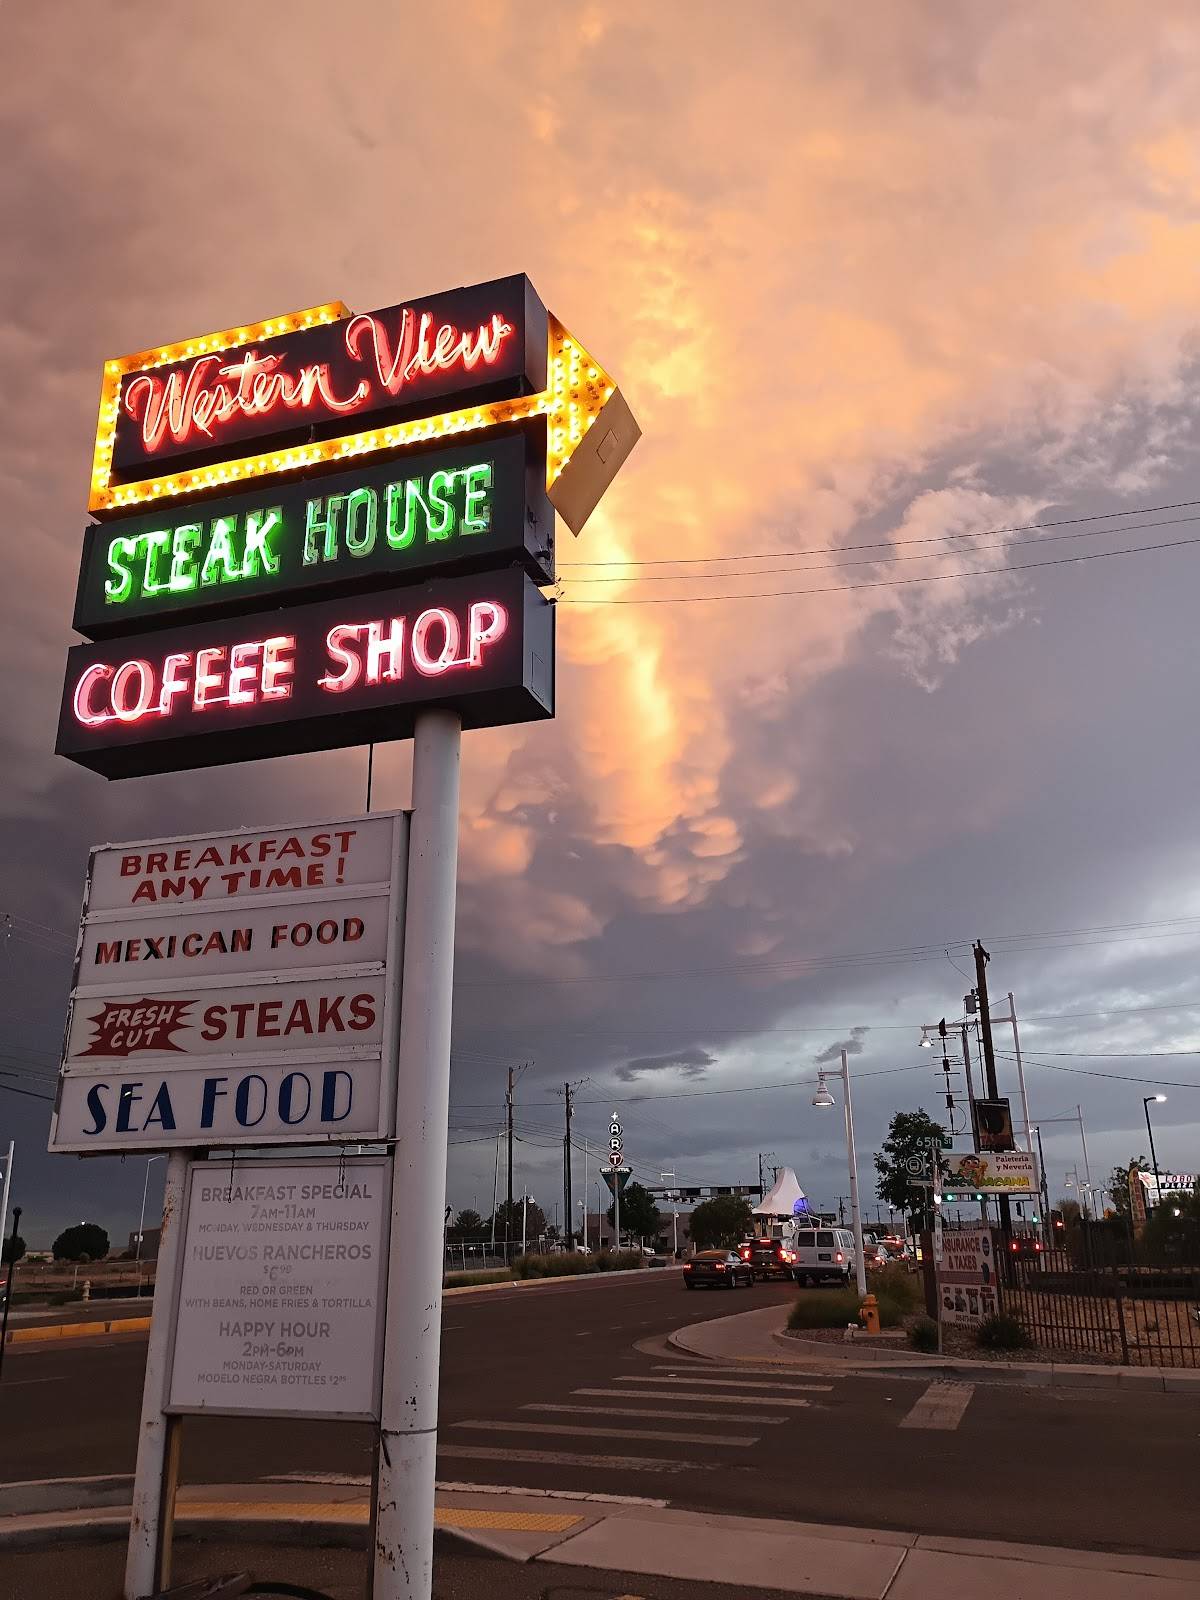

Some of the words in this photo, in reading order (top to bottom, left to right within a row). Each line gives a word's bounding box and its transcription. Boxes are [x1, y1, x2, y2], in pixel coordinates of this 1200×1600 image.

[125, 349, 368, 453] Western
[345, 306, 515, 396] View
[105, 505, 283, 604] STEAK
[302, 462, 495, 567] HOUSE
[73, 634, 297, 728] COFFEE
[318, 600, 509, 693] SHOP
[120, 831, 357, 877] BREAKFAST
[132, 875, 211, 903] ANY
[220, 858, 346, 895] TIME!
[95, 928, 253, 965] MEXICAN
[271, 917, 365, 949] FOOD
[104, 1005, 175, 1029] FRESH
[201, 993, 376, 1041] STEAKS
[110, 1026, 161, 1048] CUT
[82, 1081, 176, 1135] SEA
[200, 1070, 354, 1128] FOOD
[916, 1136, 942, 1148] 65th
[943, 1136, 952, 1145] St
[201, 1185, 297, 1202] BREAKFAST
[301, 1184, 373, 1199] SPECIAL
[306, 1222, 313, 1231] &
[316, 1221, 370, 1231] THURSDAY
[263, 1244, 372, 1261] RANCHEROS
[942, 1236, 980, 1253] NSURANCE
[954, 1255, 978, 1270] TAXES
[240, 1285, 259, 1295] RED
[262, 1285, 276, 1295] OR
[279, 1285, 313, 1295] GREEN
[185, 1298, 210, 1308] WITH
[212, 1298, 247, 1309] BEANS,
[249, 1298, 278, 1308] HOME
[281, 1298, 309, 1308] FRIES
[312, 1298, 319, 1308] &
[321, 1298, 372, 1308] TORTILLA
[219, 1322, 276, 1337] HAPPY
[280, 1322, 331, 1338] HOUR
[242, 1341, 304, 1357] 2PM-6PM
[197, 1373, 240, 1384] MODELO
[242, 1374, 277, 1384] NEGRA
[281, 1375, 327, 1385] BOTTLES
